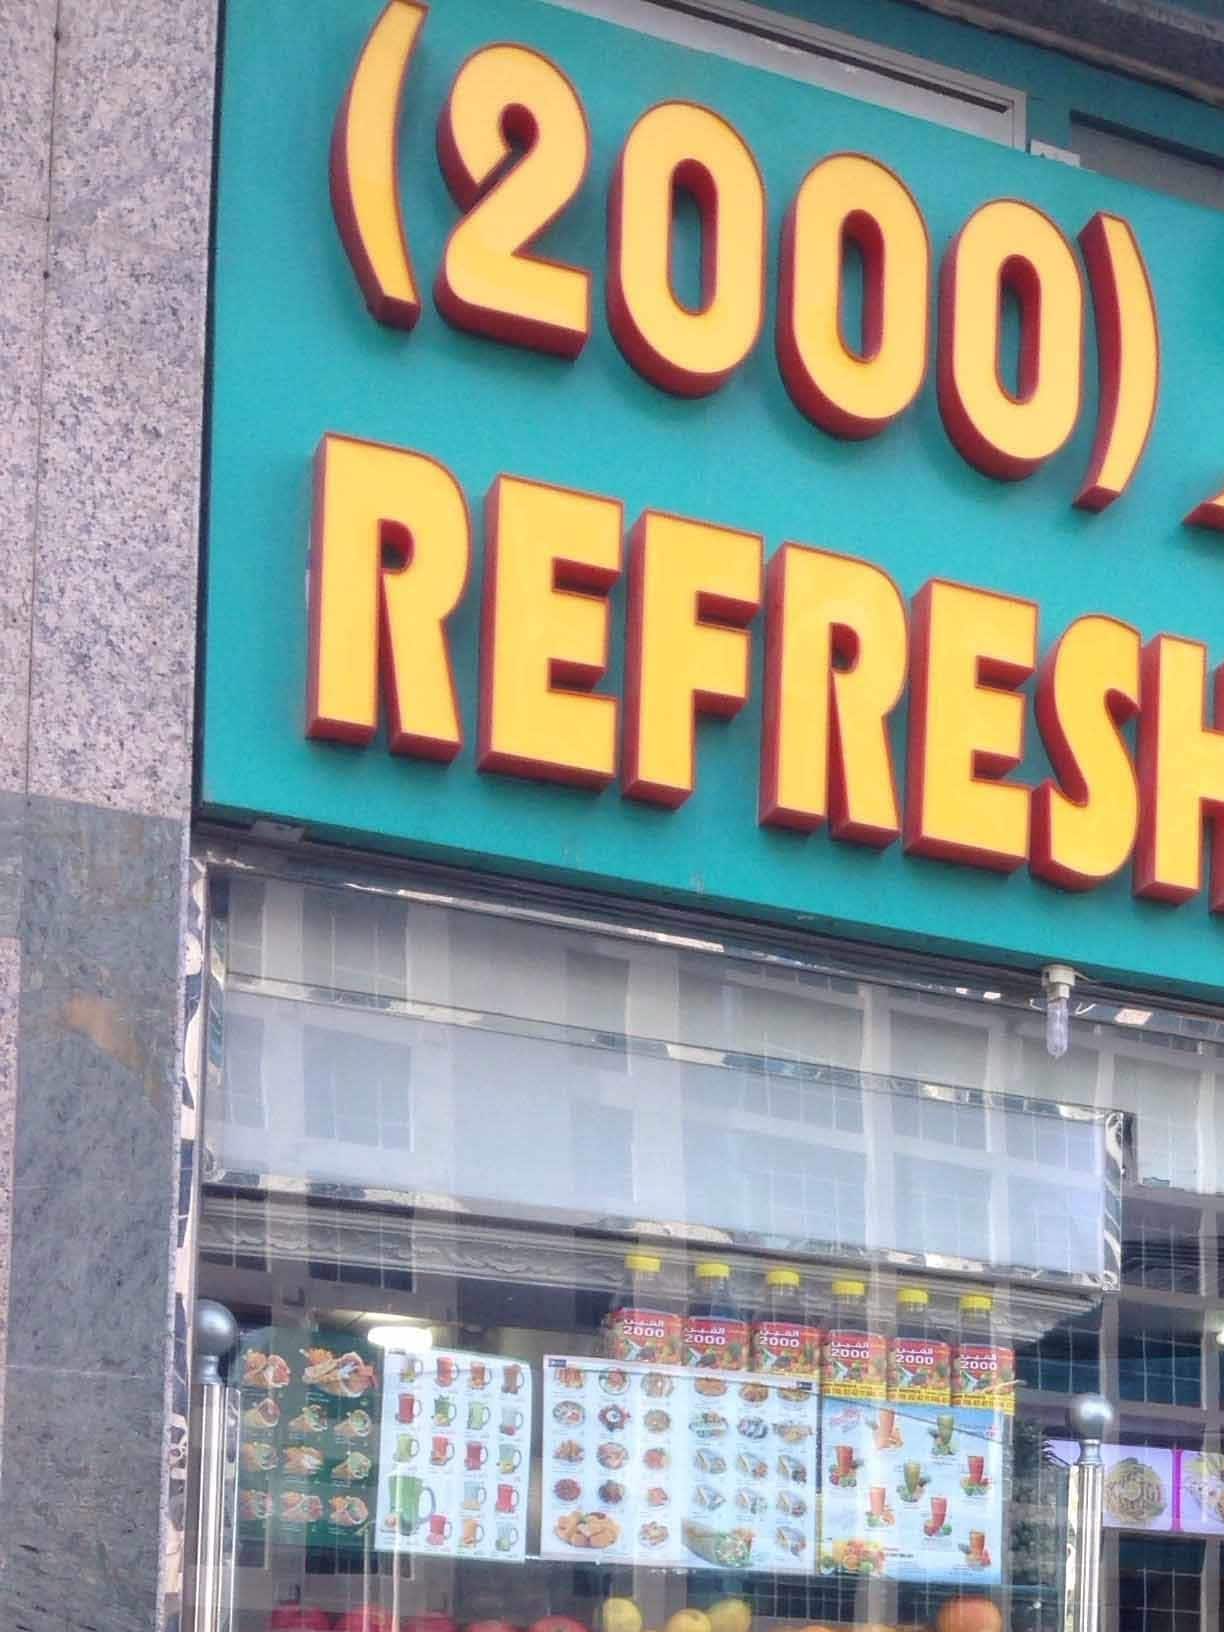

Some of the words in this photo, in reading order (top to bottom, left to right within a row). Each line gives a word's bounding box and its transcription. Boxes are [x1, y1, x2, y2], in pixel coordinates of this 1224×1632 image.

[330, 0, 1159, 512] (2000)
[623, 1325, 665, 1338] 2000
[684, 1334, 726, 1345] 2000
[759, 1336, 800, 1348] 2000
[831, 1349, 870, 1360] 2000
[896, 1354, 934, 1366] 2000
[960, 1360, 998, 1371] 2000
